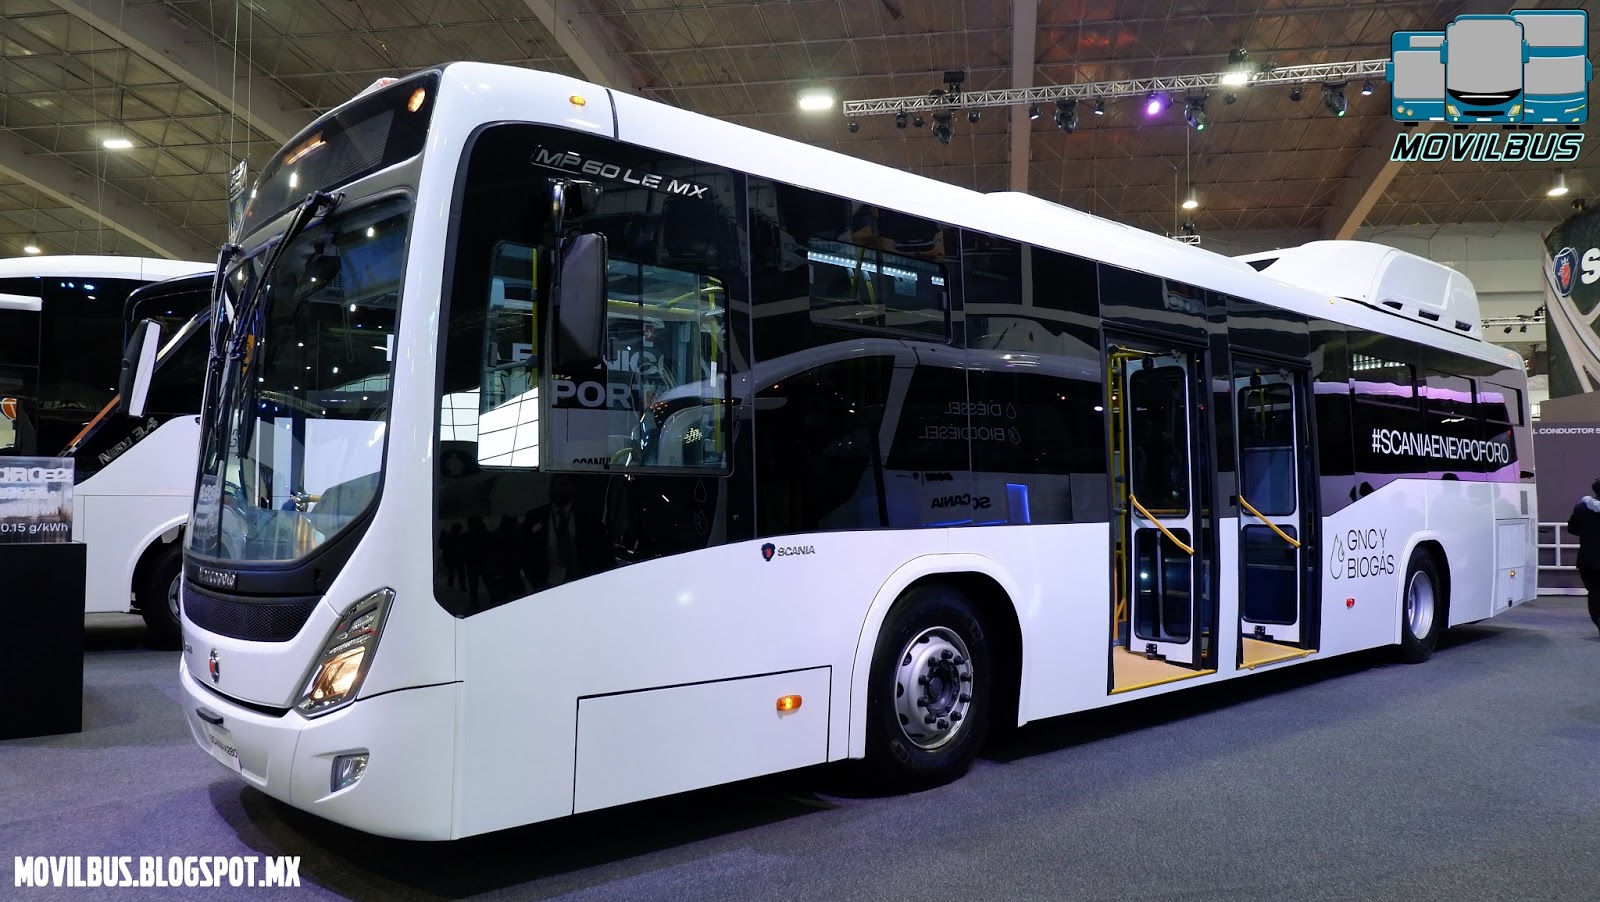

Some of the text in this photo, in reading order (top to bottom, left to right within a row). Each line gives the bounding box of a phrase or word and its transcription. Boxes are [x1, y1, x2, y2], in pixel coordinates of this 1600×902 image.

[535, 148, 709, 199] MP 60 LE MX
[1539, 427, 1595, 435] CONDUCTOR
[1372, 428, 1510, 463] #SCANIAENEXPOFORO
[1, 522, 69, 534] 0.15 g/kWh
[1347, 528, 1387, 551] GNC Y
[777, 545, 816, 557] SCANIA
[1347, 551, 1395, 579] BIOGÁS
